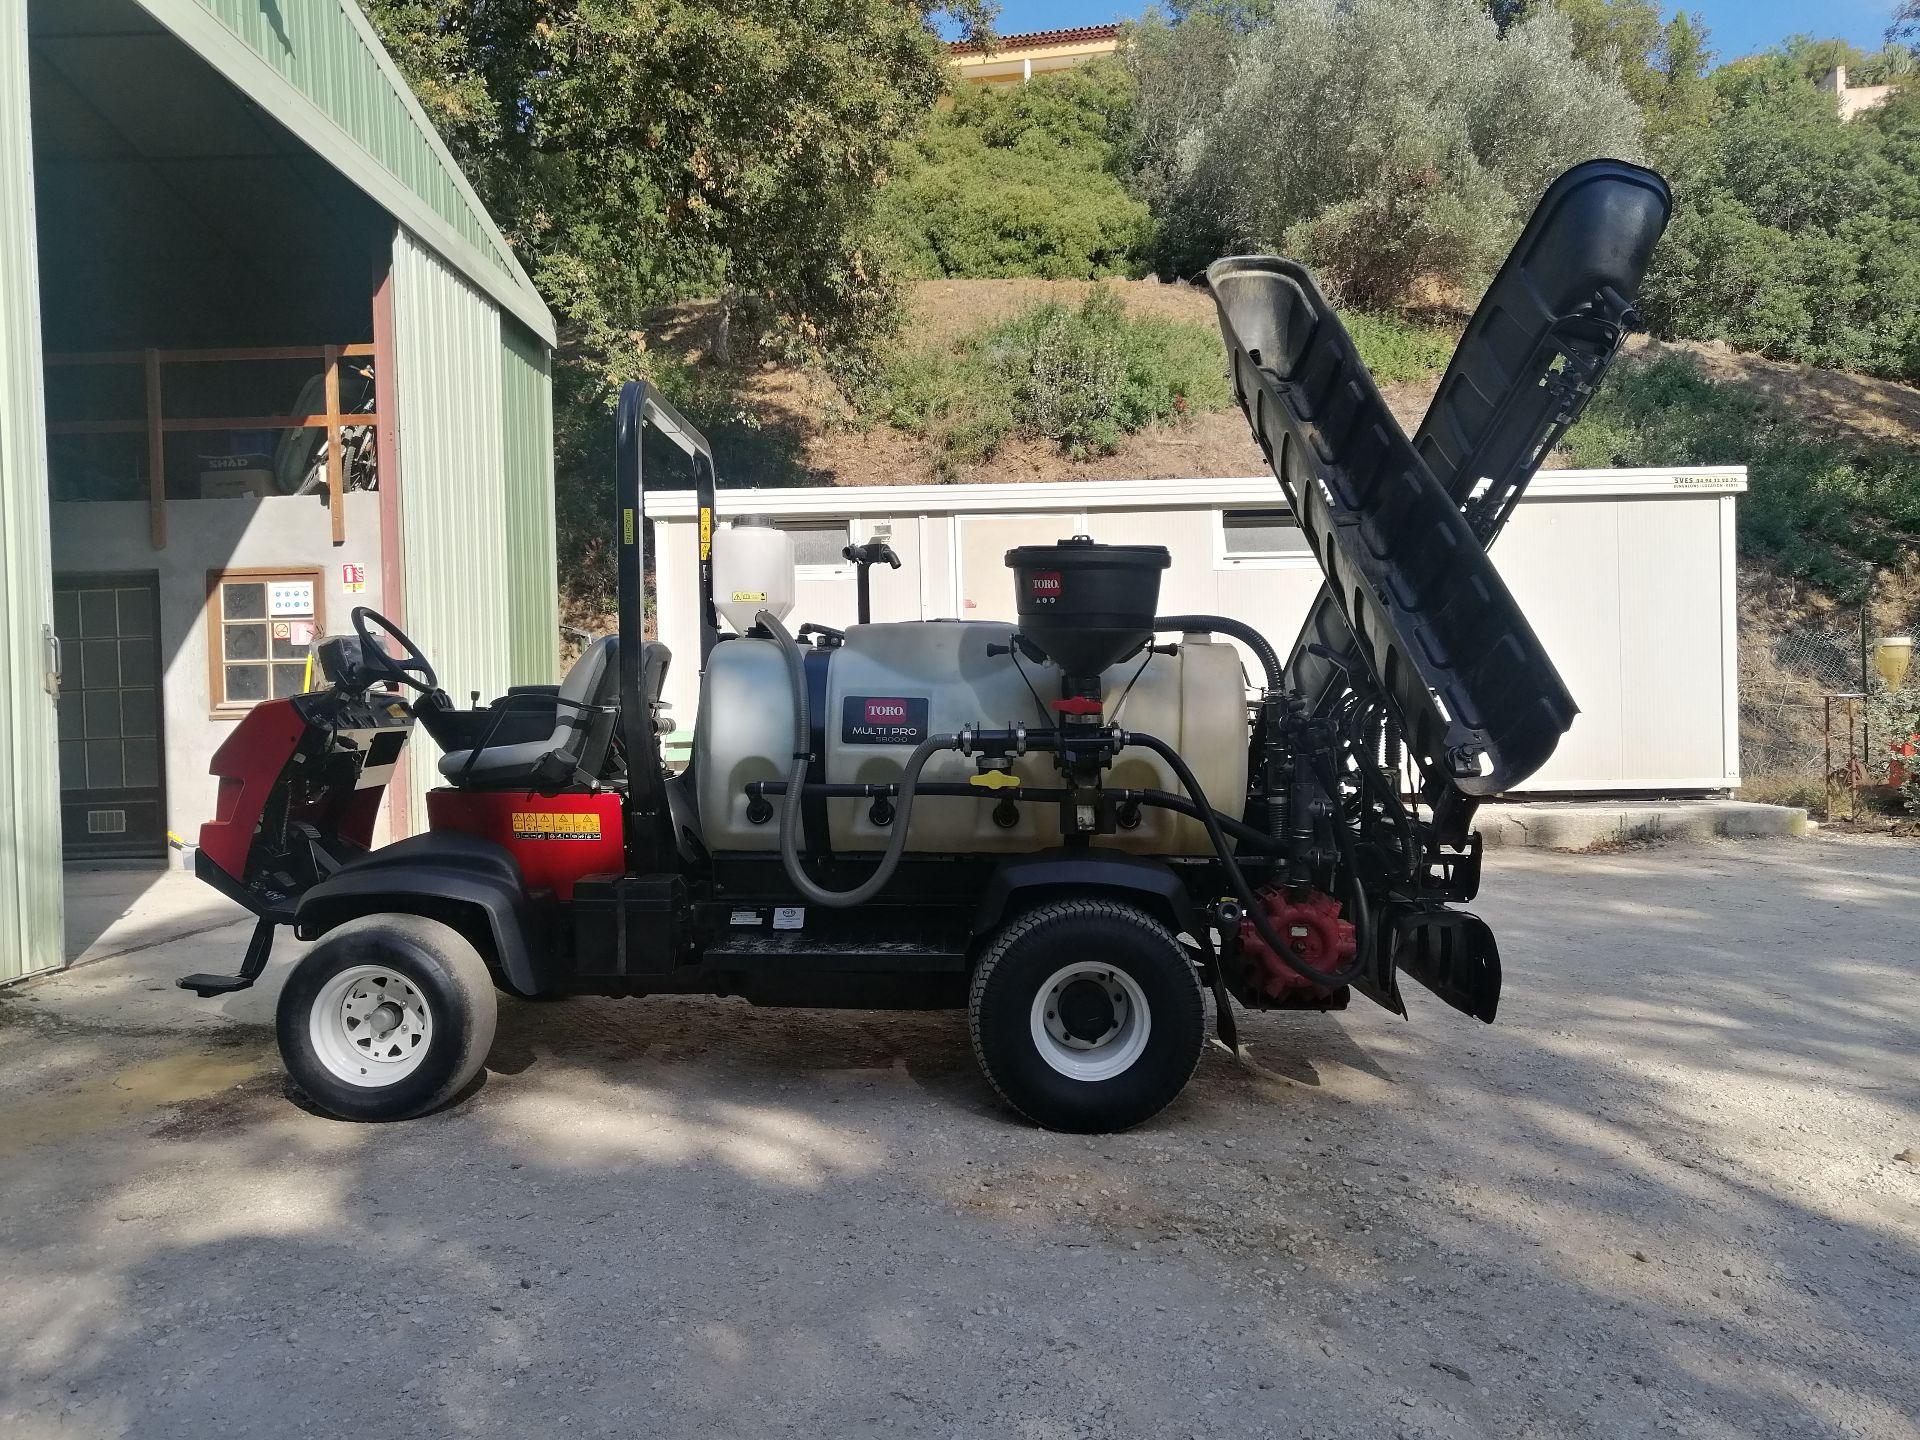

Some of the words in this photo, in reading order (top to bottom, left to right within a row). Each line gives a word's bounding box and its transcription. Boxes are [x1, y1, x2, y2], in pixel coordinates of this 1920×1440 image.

[209, 459, 248, 468] SHAD
[1032, 579, 1059, 589] TORO
[868, 706, 904, 716] TORO
[852, 727, 886, 735] MULTI
[891, 727, 917, 736] PRO
